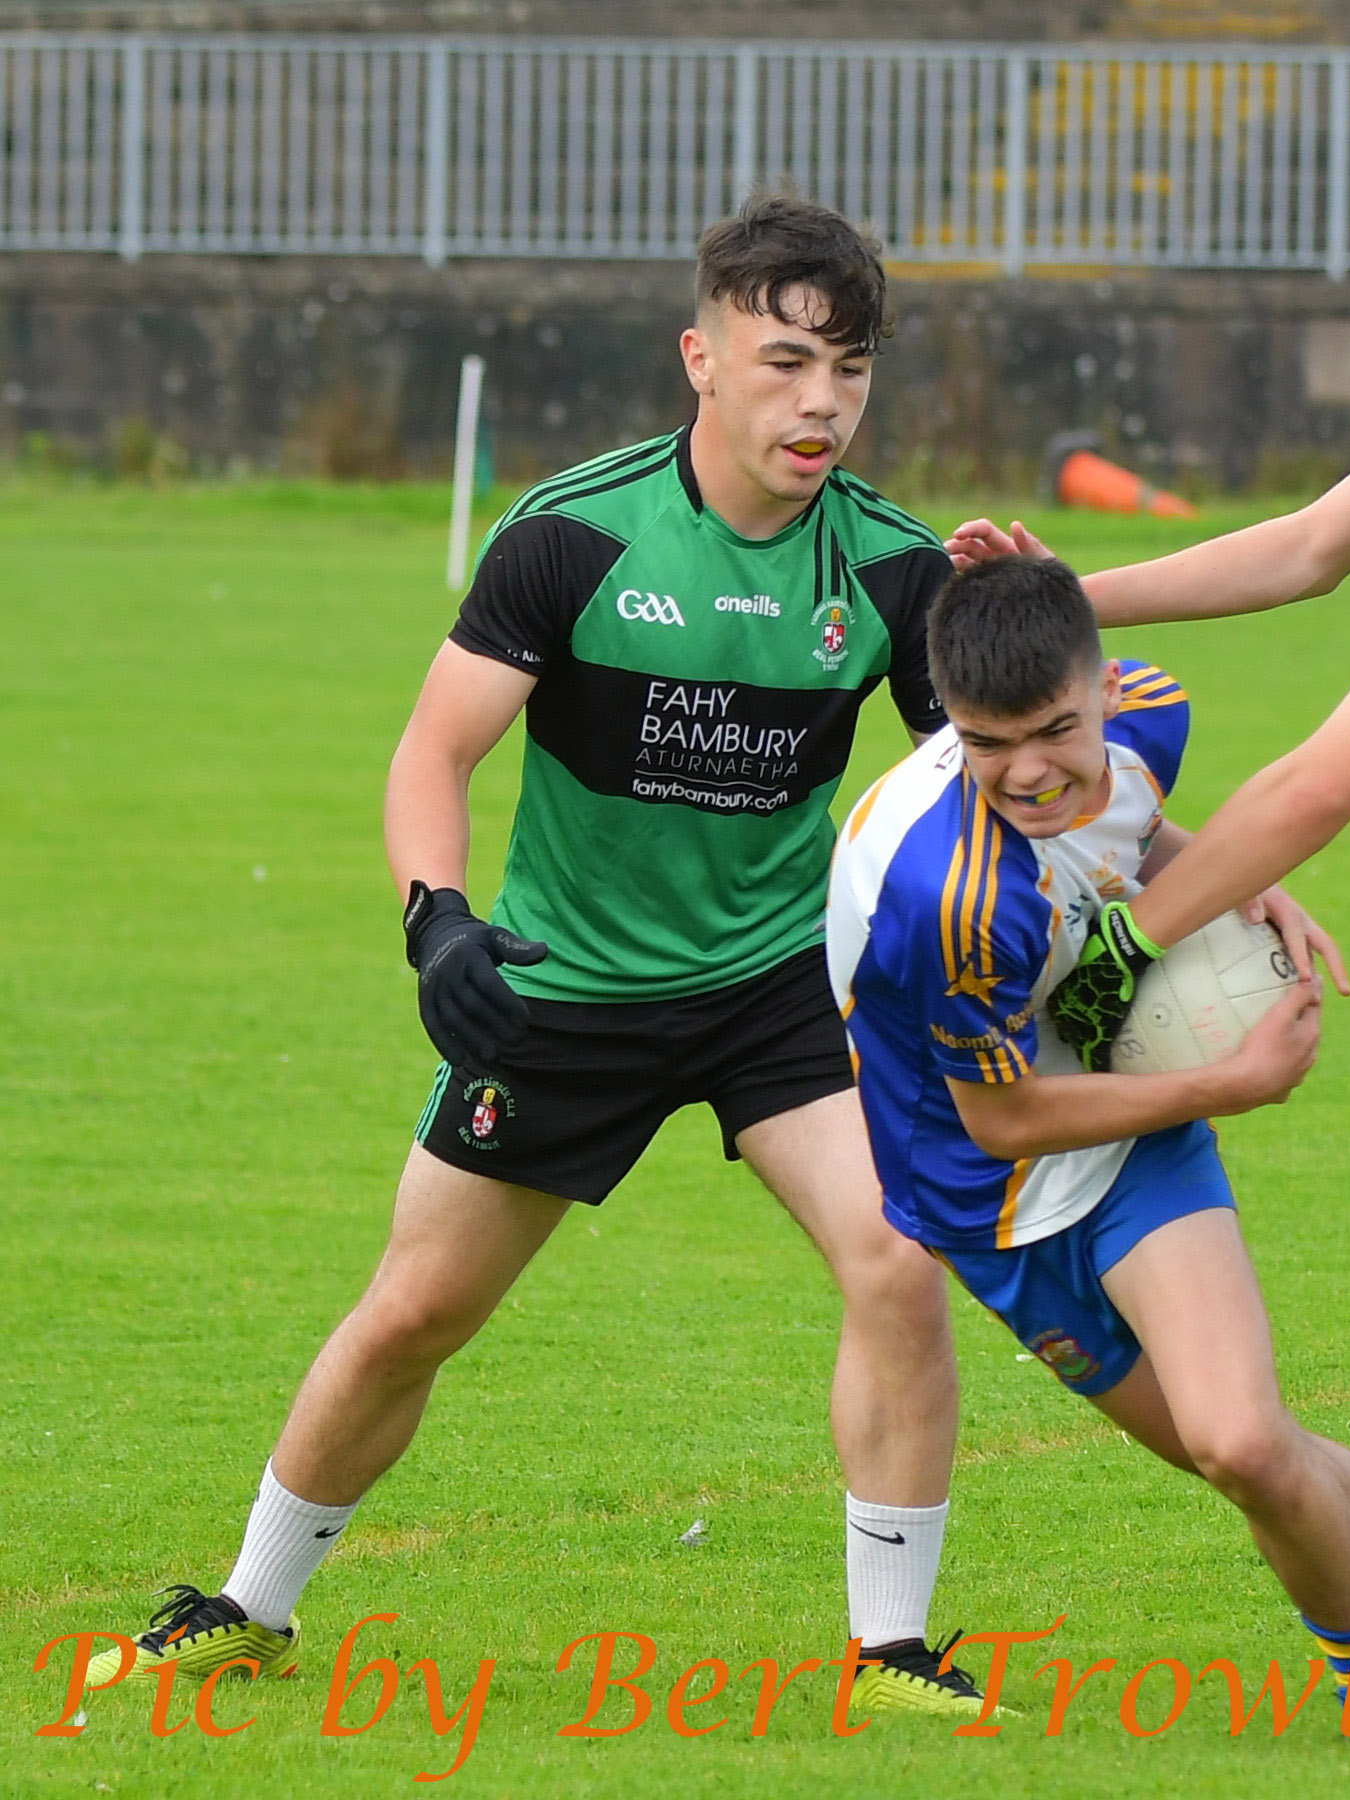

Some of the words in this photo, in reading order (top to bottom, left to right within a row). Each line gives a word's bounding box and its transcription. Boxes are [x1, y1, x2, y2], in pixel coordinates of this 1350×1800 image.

[617, 589, 685, 626] GAA
[645, 681, 737, 718] FAHY
[640, 714, 808, 758] BAMBURY
[635, 748, 799, 780] ATURNAETHA
[632, 778, 788, 810] fahybambury.com
